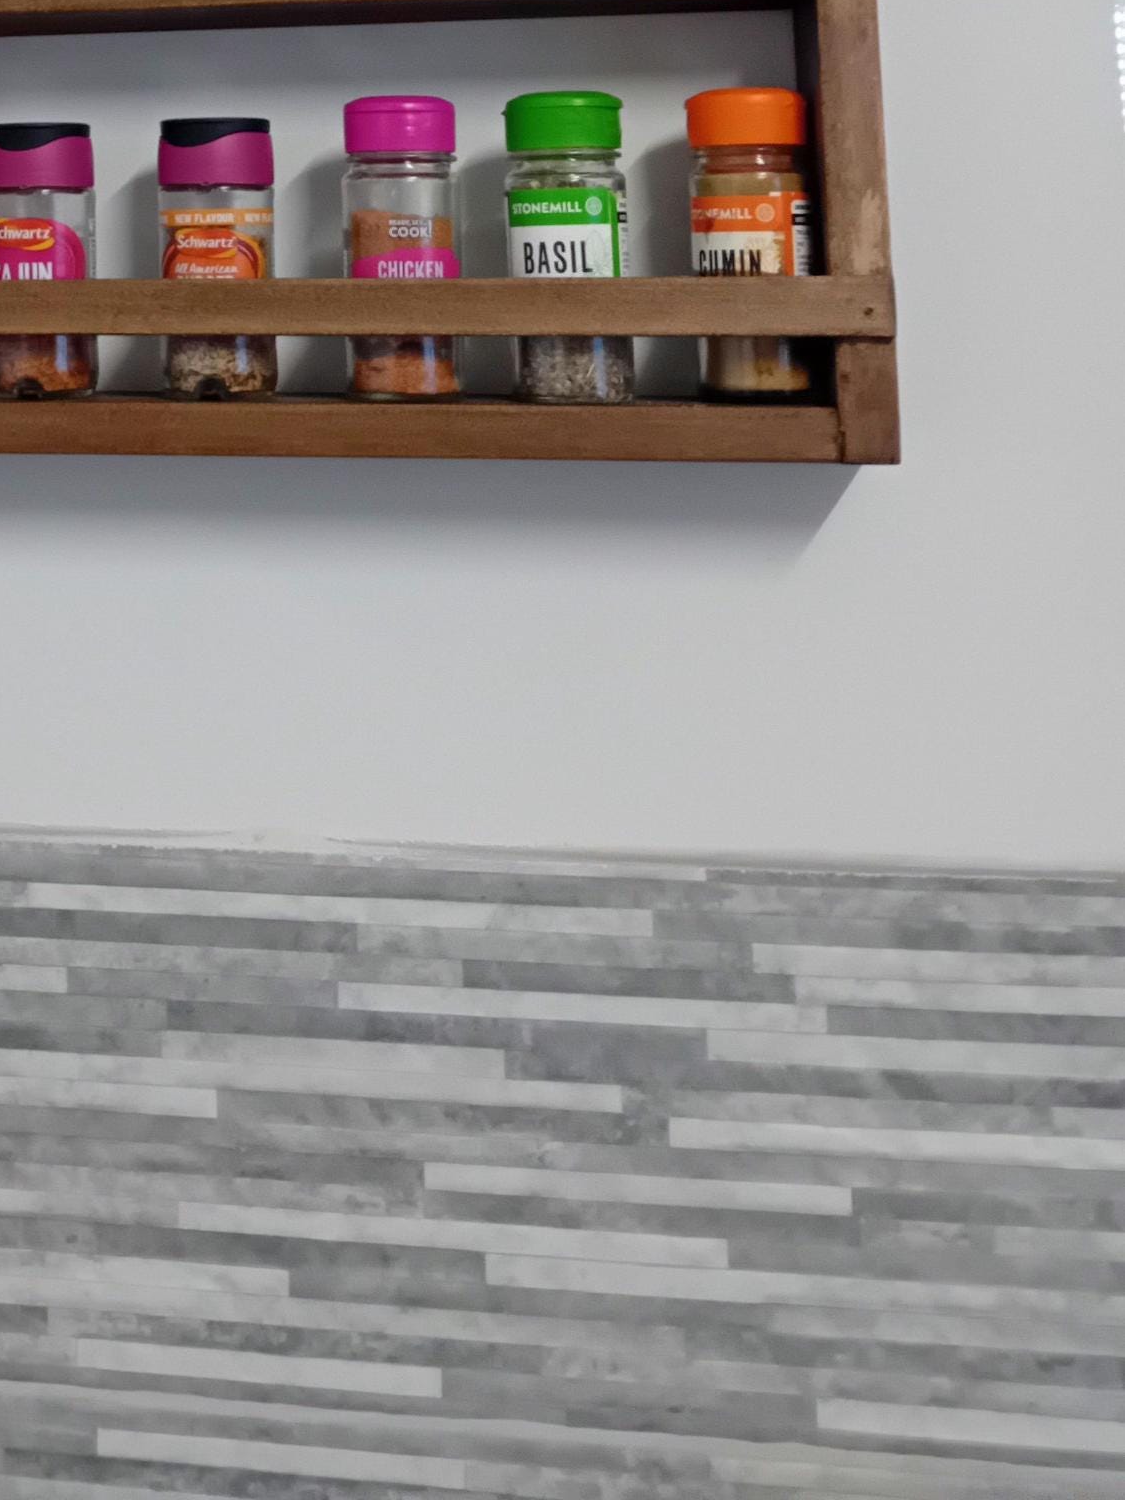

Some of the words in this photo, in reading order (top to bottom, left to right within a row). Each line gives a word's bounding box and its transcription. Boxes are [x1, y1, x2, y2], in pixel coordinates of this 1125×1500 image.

[512, 201, 582, 214] STONEMILL
[388, 219, 432, 238] COOK!
[177, 235, 235, 249] Schwartz
[523, 240, 593, 274] BASIL
[699, 249, 761, 276] CUMIN
[378, 260, 443, 279] CHICKEN
